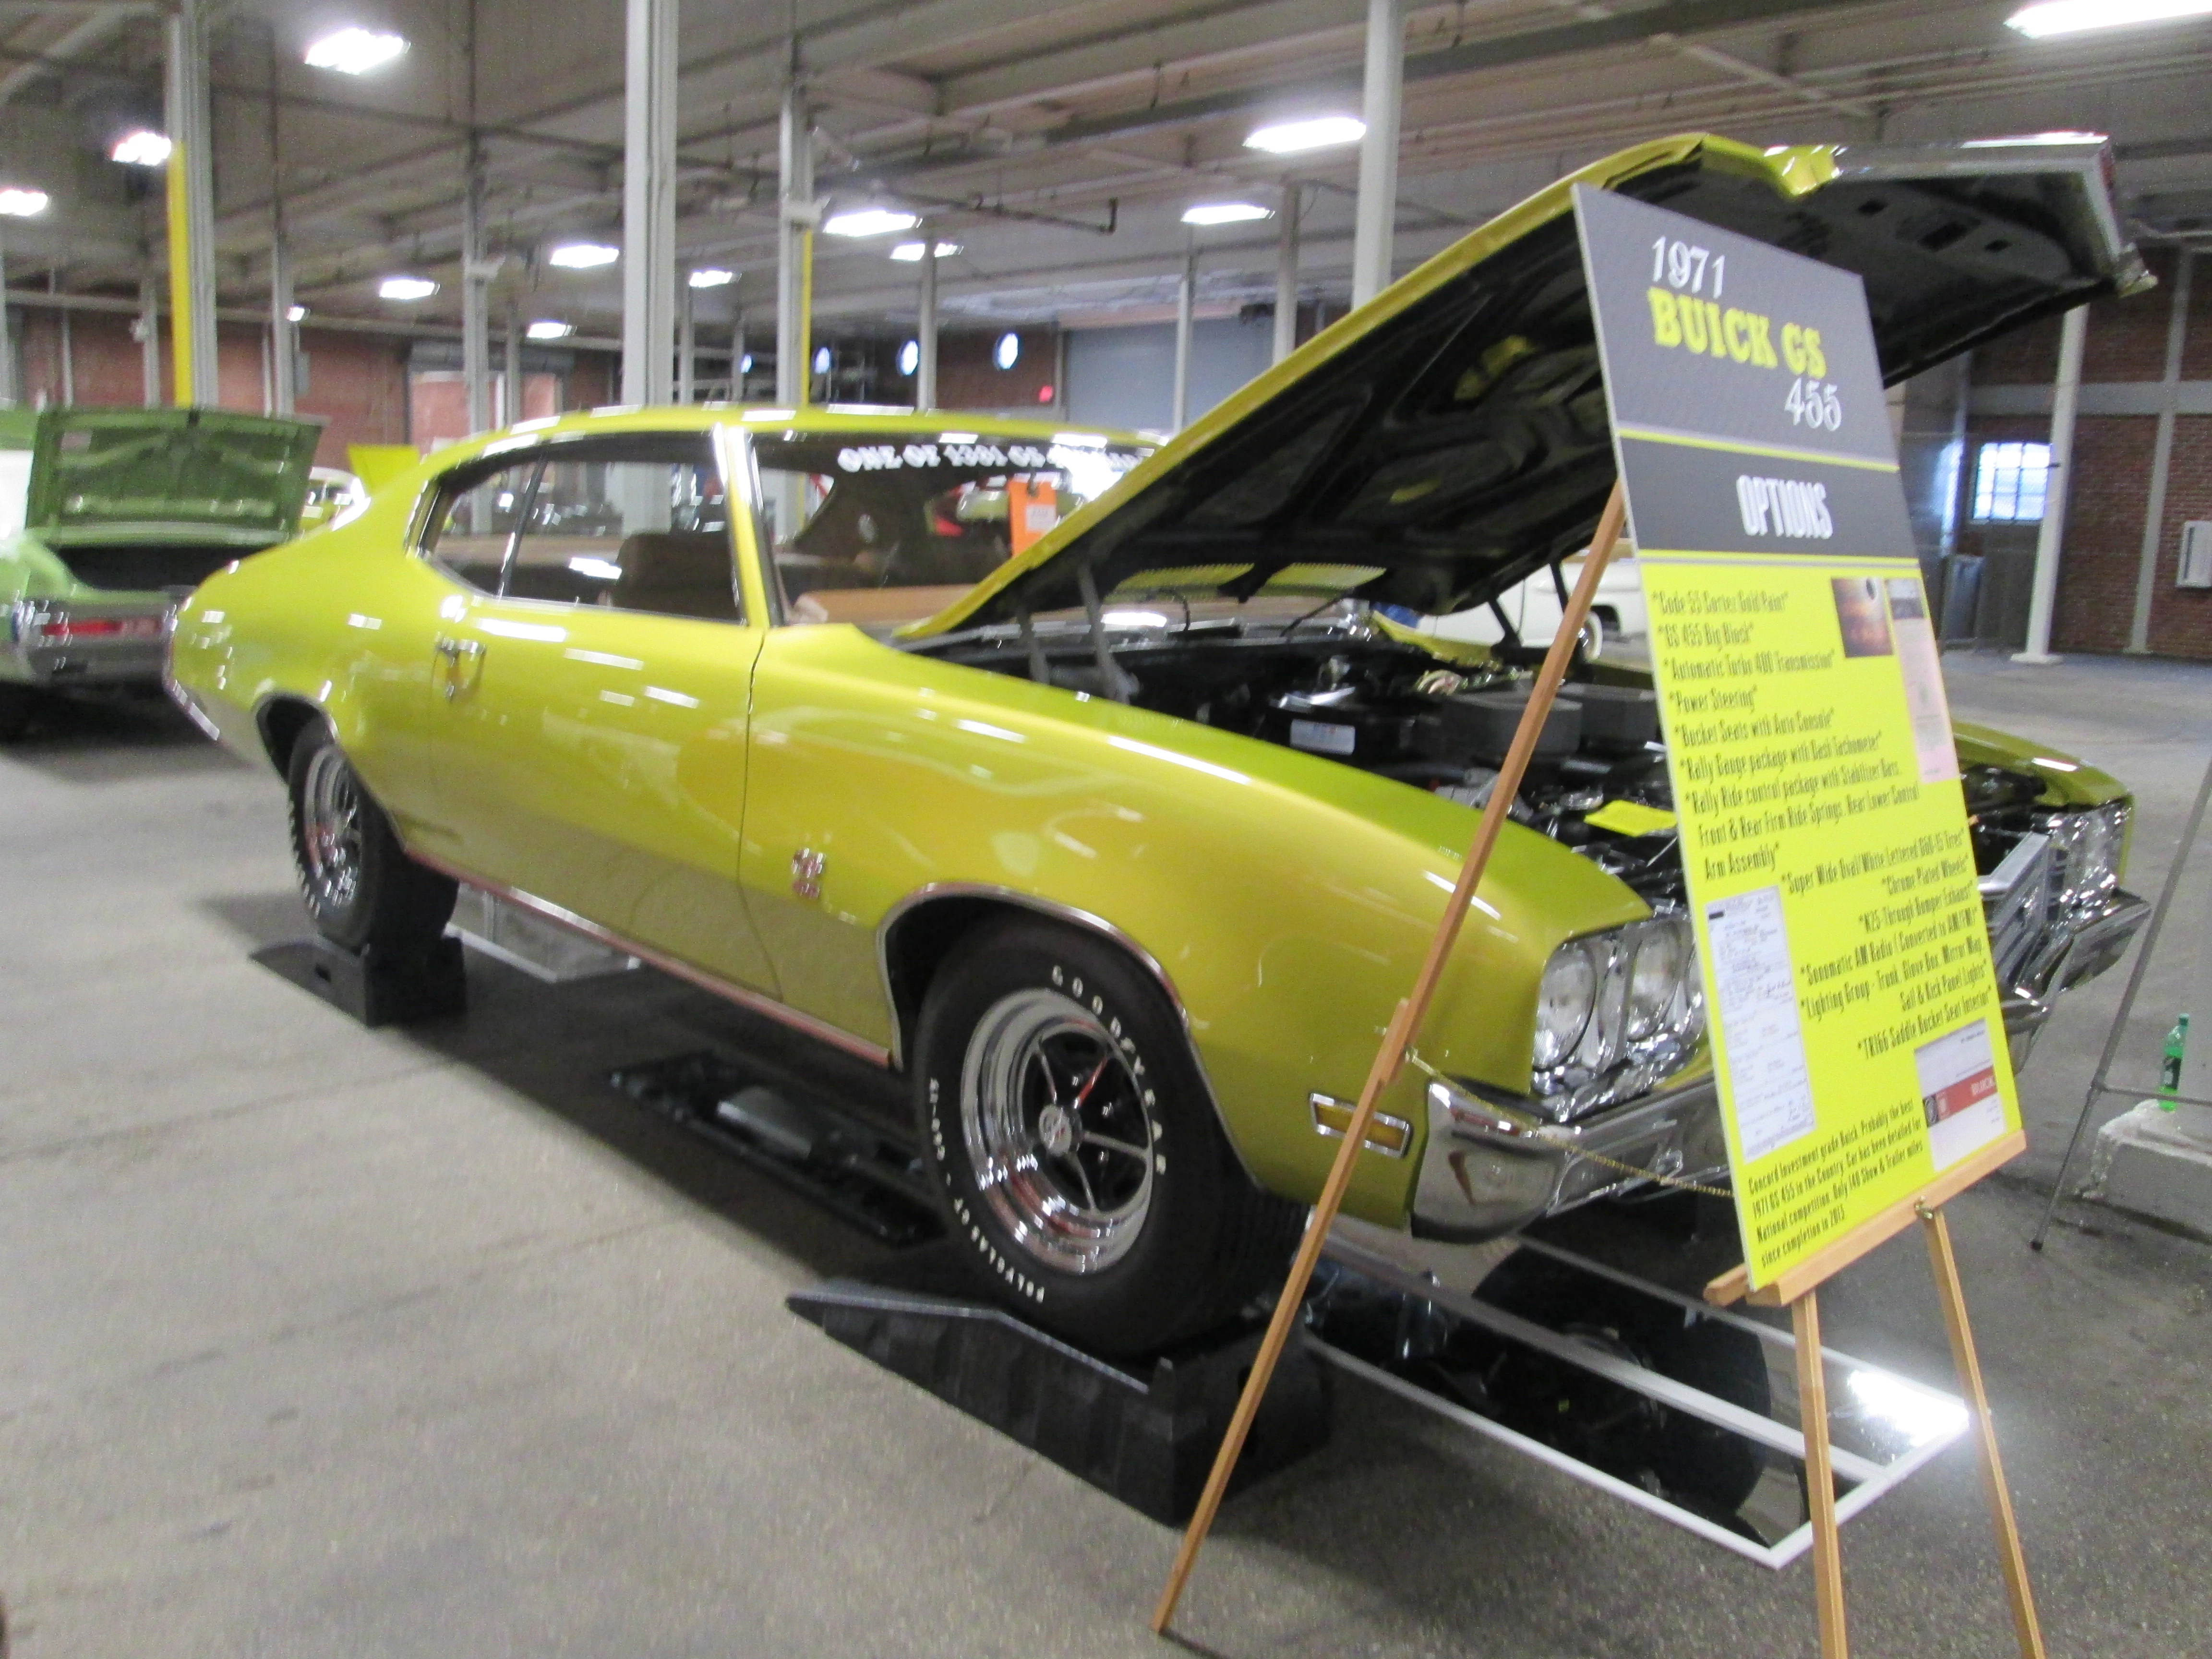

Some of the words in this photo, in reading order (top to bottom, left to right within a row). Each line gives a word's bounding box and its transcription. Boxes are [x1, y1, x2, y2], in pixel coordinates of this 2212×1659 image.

[1652, 235, 1725, 299] 1971
[1647, 286, 1778, 369] BUICK
[1780, 322, 1827, 379] GS
[1784, 378, 1842, 432] 455
[837, 444, 904, 473] ONE
[902, 444, 941, 468] OF
[1736, 475, 1833, 540] OPTIONS
[1704, 622, 1722, 652] Big
[1719, 719, 1749, 742] Seats
[1752, 713, 1772, 738] with
[1773, 712, 1795, 735] Auto
[1716, 752, 1745, 781] Gauge
[1750, 745, 1787, 779] package
[1791, 740, 1810, 764] with
[1810, 737, 1832, 761] Dash
[1721, 783, 1743, 809] Ride
[1746, 776, 1781, 805] control
[1783, 772, 1818, 802] package
[1821, 766, 1840, 789] with
[1840, 761, 1880, 785] Stabilizer
[1698, 823, 1727, 849] Front
[1729, 817, 1739, 841] &
[1740, 815, 1762, 839] Rear
[1763, 810, 1788, 834] Firm
[1788, 805, 1807, 828] Ride
[1846, 793, 1866, 815] Rear
[1866, 790, 1890, 811] Lower
[1890, 780, 1920, 805] Control
[1705, 856, 1726, 881] Arm
[1815, 861, 1838, 886] Wide
[1886, 837, 1919, 866] Lettered
[1916, 863, 1941, 885] Plated
[1915, 893, 1944, 917] Bumper
[1854, 943, 1870, 968] AM
[1870, 938, 1894, 962] Radio
[1937, 919, 1947, 937] to
[1844, 979, 1871, 1002] Group
[1902, 958, 1924, 981] Glove
[1941, 943, 1966, 965] Mirror
[1916, 984, 1925, 1005] &
[1924, 976, 1943, 1001] Kick
[1942, 967, 1963, 994] Panel
[1889, 1018, 1917, 1048] Saddle
[1917, 1008, 1944, 1035] Bucket
[1944, 1001, 1962, 1023] Seat
[1748, 1164, 1780, 1195] Concord
[1779, 1146, 1819, 1178] Investment
[1820, 1134, 1840, 1162] grade
[1861, 1109, 1889, 1136] Probably
[1889, 1104, 1900, 1120] the
[1899, 1098, 1914, 1116] best
[1752, 1195, 1770, 1221] 1971
[1769, 1190, 1781, 1211] GS
[1781, 1181, 1795, 1203] 455
[1796, 1180, 1804, 1197] in
[1804, 1172, 1816, 1192] the
[1846, 1151, 1858, 1168] Car
[1858, 1145, 1871, 1161] has
[1871, 1138, 1887, 1154] been
[1887, 1122, 1912, 1146] detailed
[1911, 1117, 1922, 1131] for
[1756, 1211, 1789, 1244] National
[1832, 1180, 1849, 1201] Only
[1860, 1166, 1879, 1184] Show
[1879, 1157, 1886, 1175] &
[1885, 1149, 1907, 1169] Trailer
[1906, 1139, 1923, 1158] miles
[1761, 1245, 1781, 1269] since
[1781, 1221, 1822, 1255] completion
[1821, 1217, 1829, 1231] in
[1828, 1202, 1846, 1227] 2015
